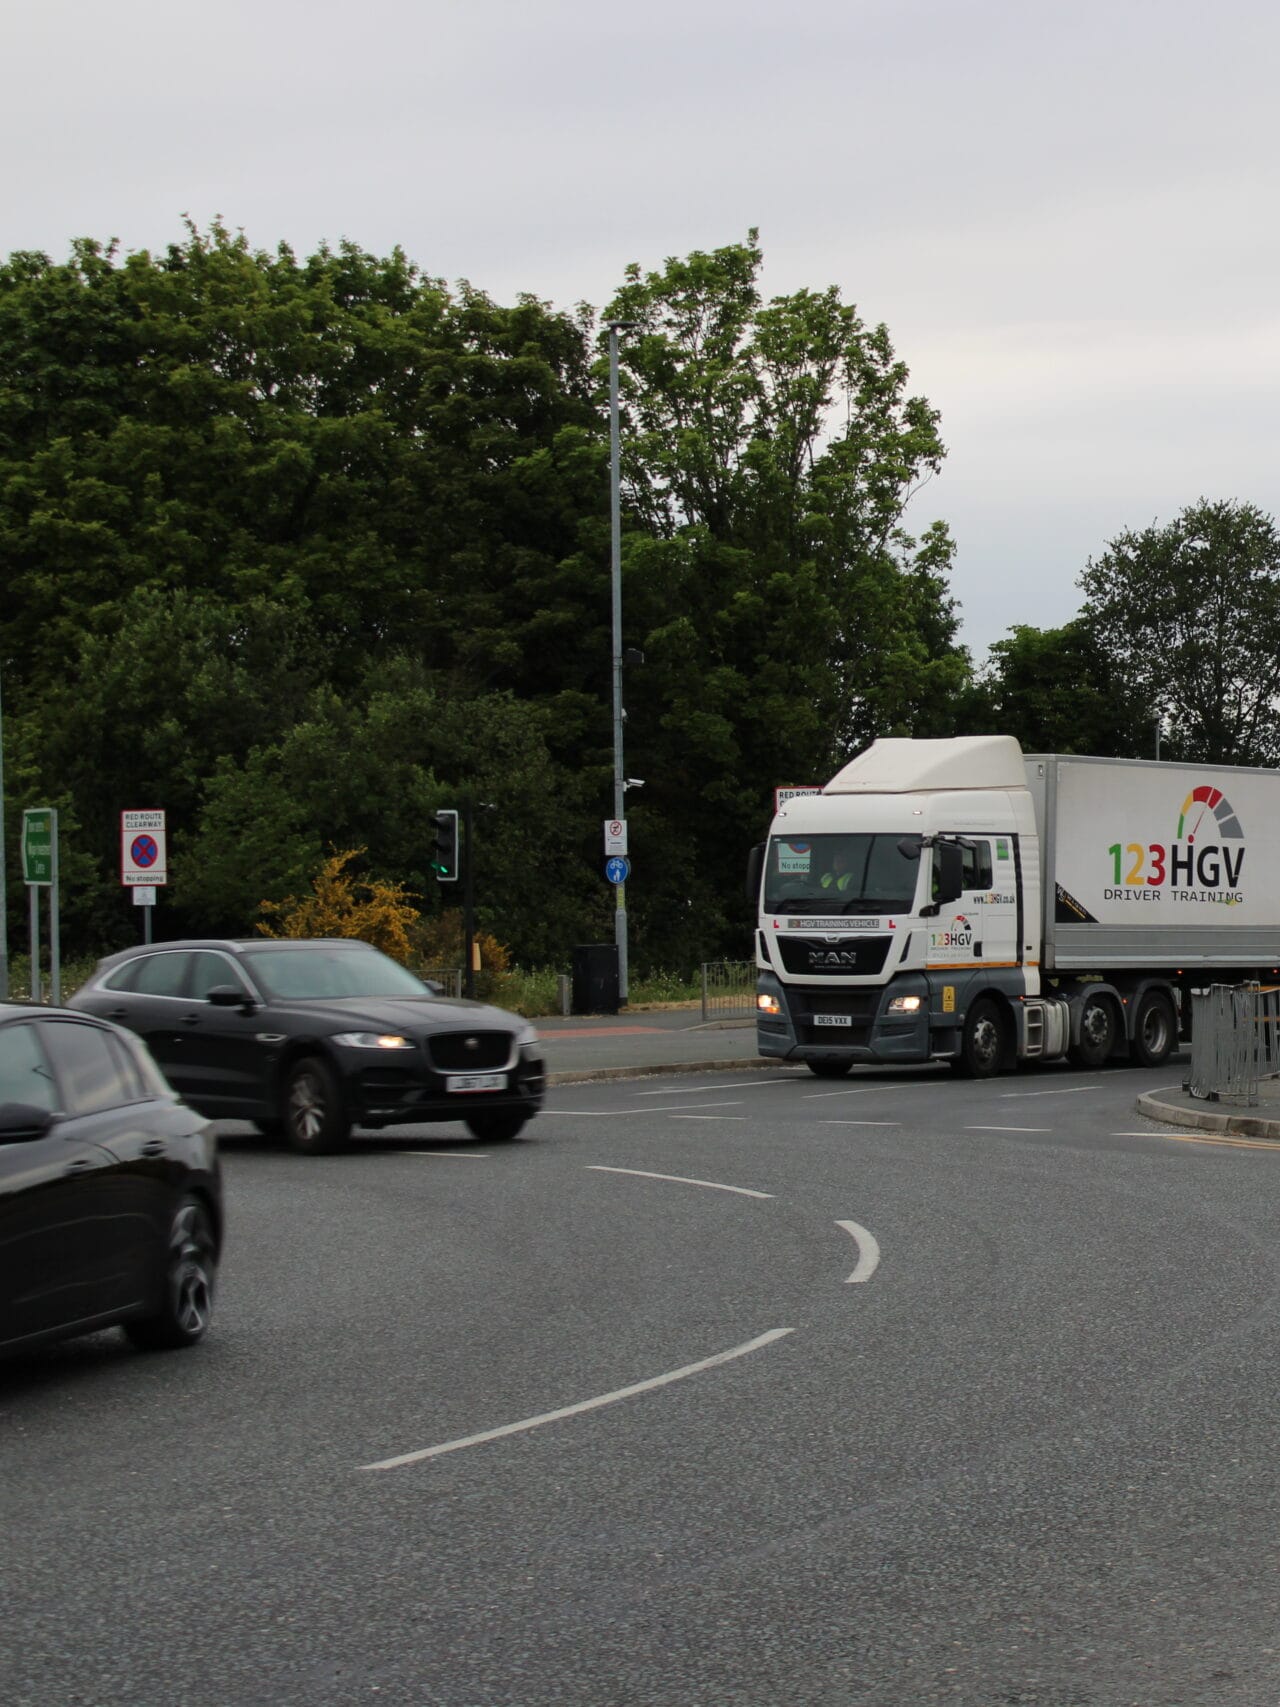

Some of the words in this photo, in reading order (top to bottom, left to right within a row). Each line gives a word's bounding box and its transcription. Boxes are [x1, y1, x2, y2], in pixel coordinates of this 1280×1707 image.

[779, 791, 794, 799] RED
[782, 862, 791, 870] No
[1108, 843, 1246, 888] 123HGV
[1104, 889, 1161, 901] DRIVER
[1171, 890, 1243, 903] TRAINING
[817, 919, 850, 928] TRAINING
[850, 919, 879, 928] VEHICLE
[932, 933, 972, 946] 123HGV
[808, 952, 856, 964] MAN
